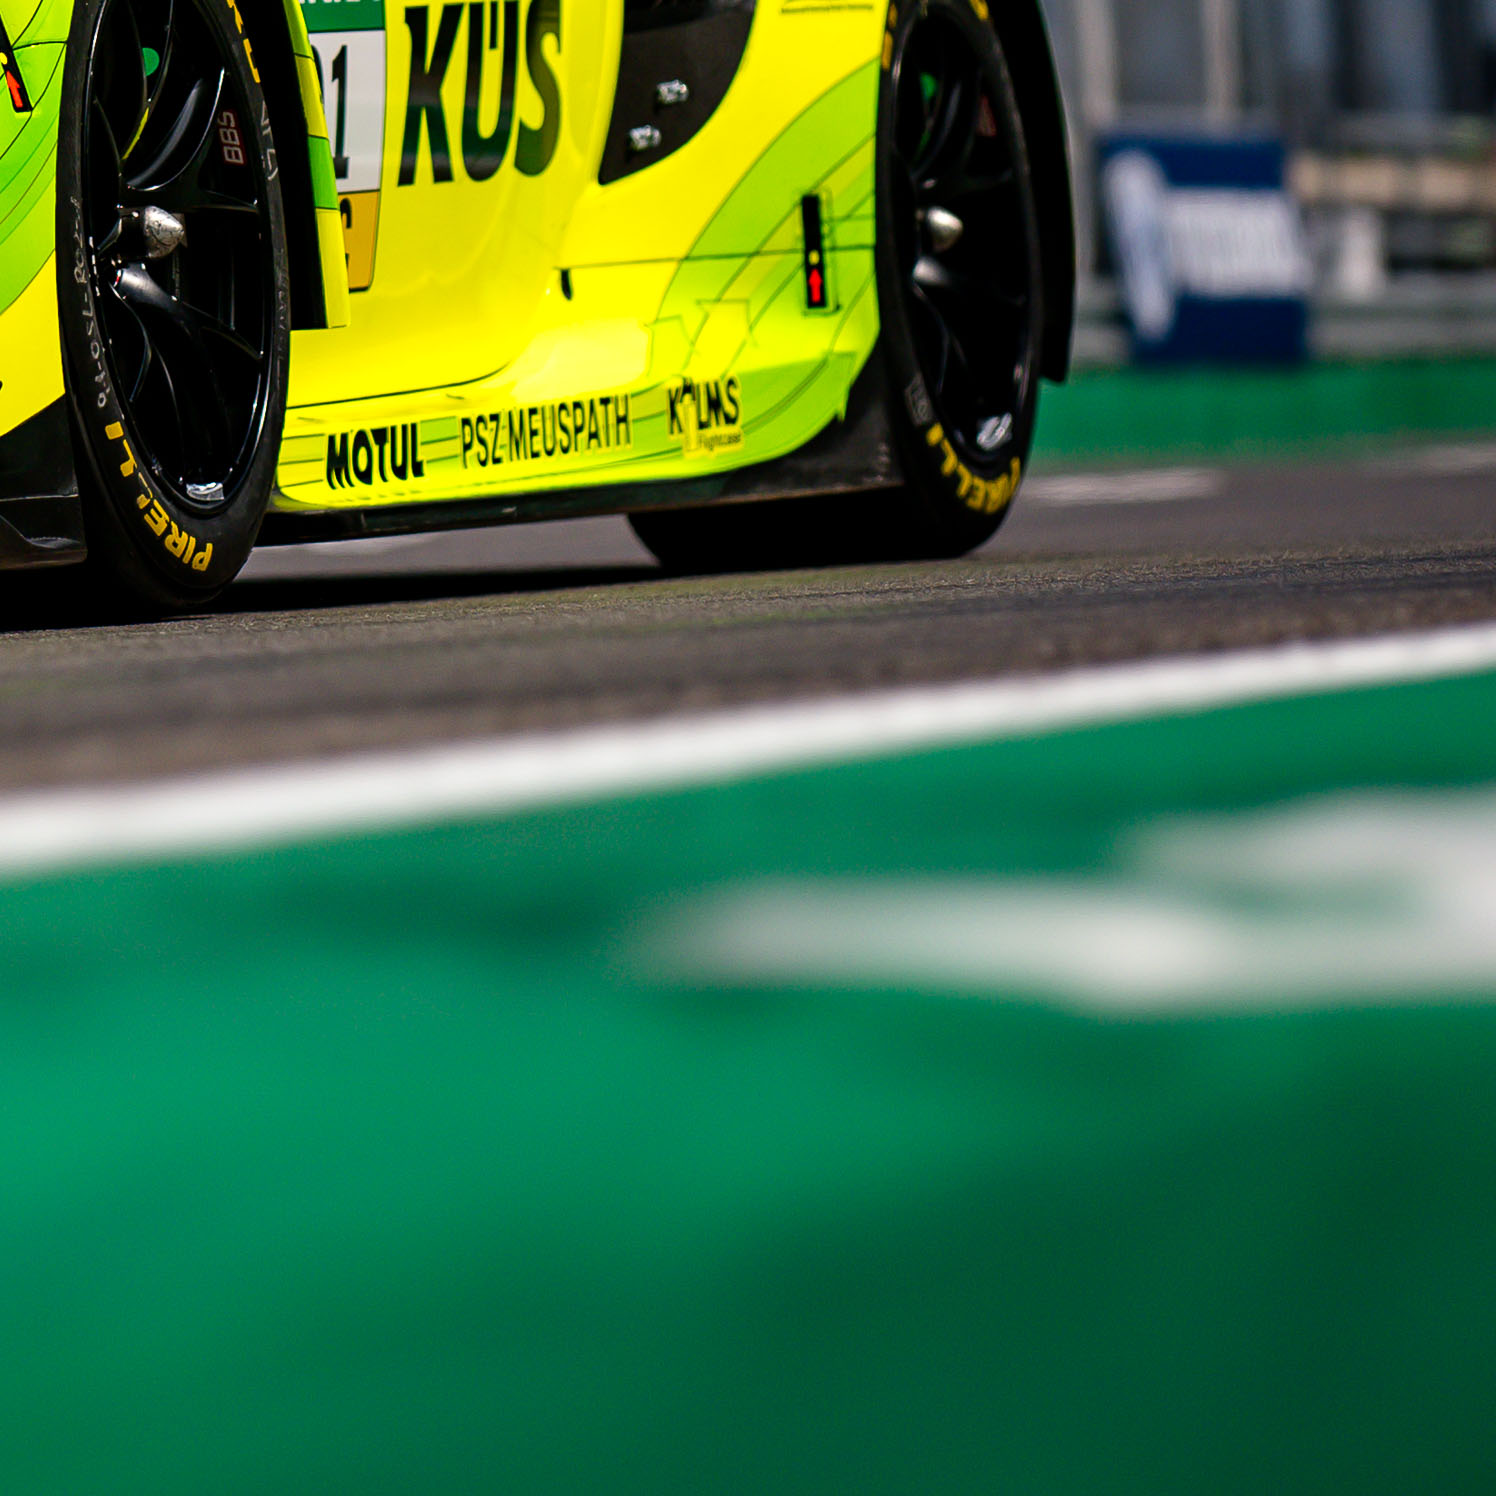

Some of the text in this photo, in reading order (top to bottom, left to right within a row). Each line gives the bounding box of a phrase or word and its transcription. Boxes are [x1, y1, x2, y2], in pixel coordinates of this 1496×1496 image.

[218, 112, 245, 165] BBS
[326, 423, 425, 490] MOTUL
[461, 414, 504, 469] PSZ
[508, 393, 632, 463] MEUSPATH
